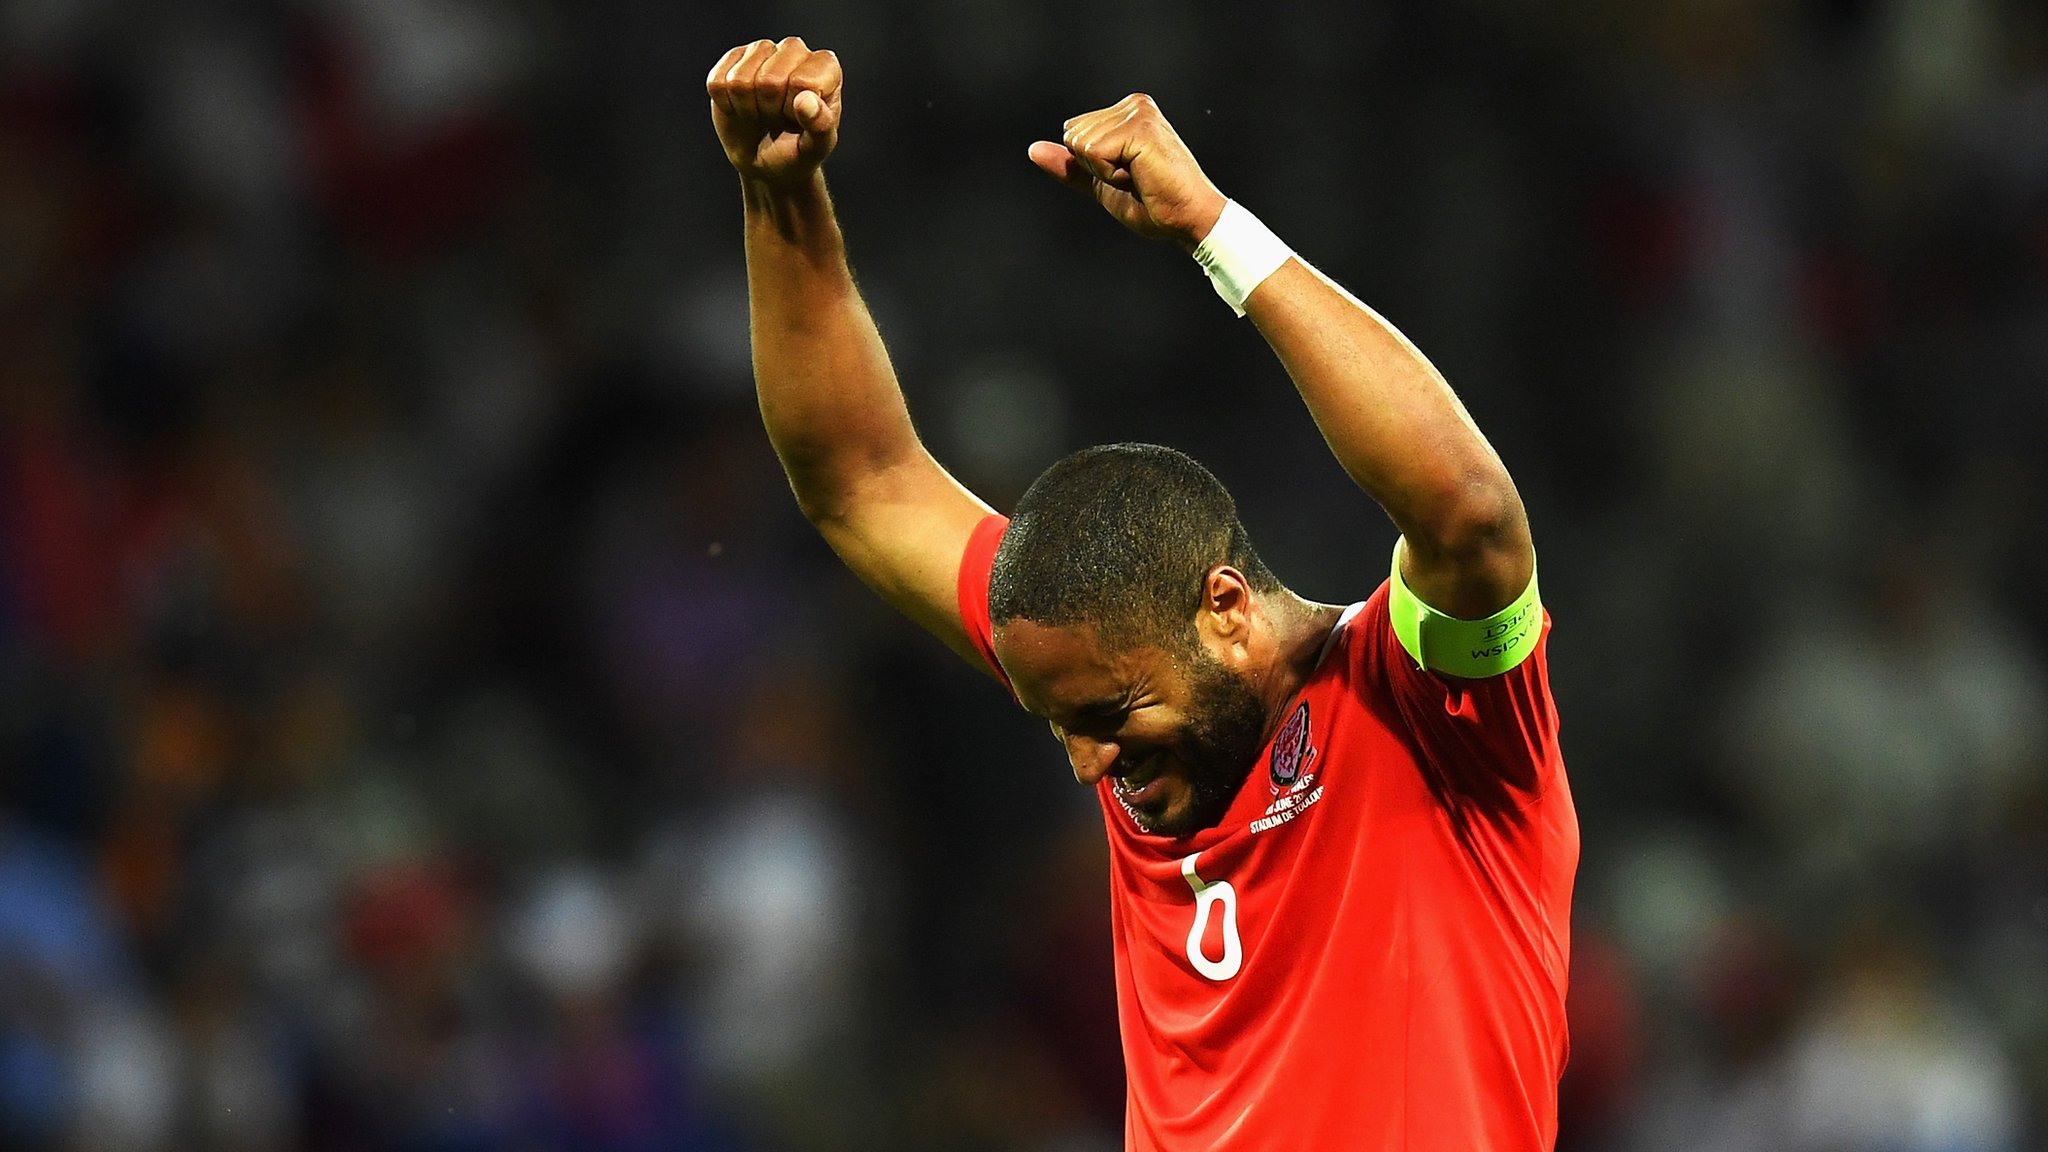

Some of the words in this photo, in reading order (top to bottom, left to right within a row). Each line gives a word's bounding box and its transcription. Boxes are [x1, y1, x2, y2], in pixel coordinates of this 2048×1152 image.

[1274, 796, 1295, 813] JUNE
[1250, 814, 1284, 834] STADIUM
[1281, 809, 1295, 823] DE
[1181, 851, 1243, 981] 6
